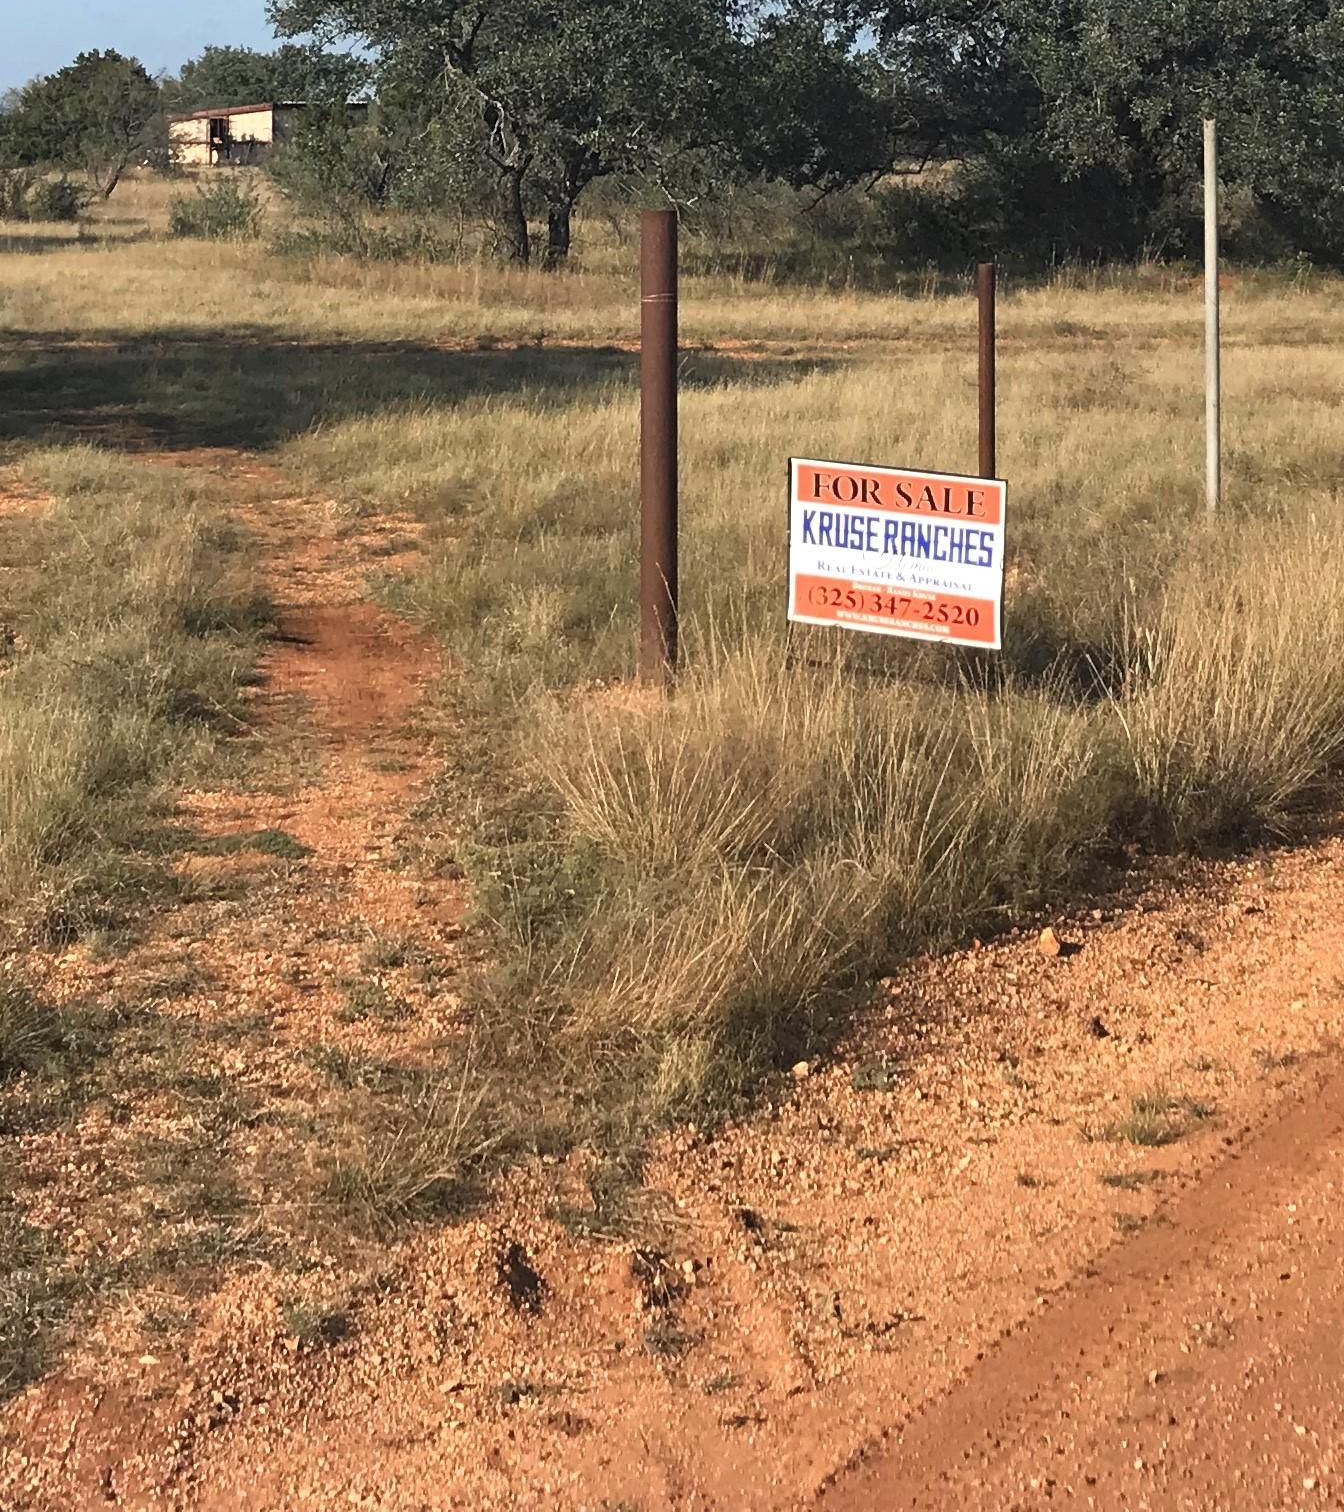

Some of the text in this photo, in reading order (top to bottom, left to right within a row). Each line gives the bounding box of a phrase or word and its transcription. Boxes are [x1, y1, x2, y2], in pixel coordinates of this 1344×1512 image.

[813, 473, 986, 517] FOR SALE
[802, 509, 881, 552] KRUSE
[884, 519, 995, 568] RANCHES
[896, 571, 905, 581] &
[808, 585, 980, 627] (325) 347-2520
